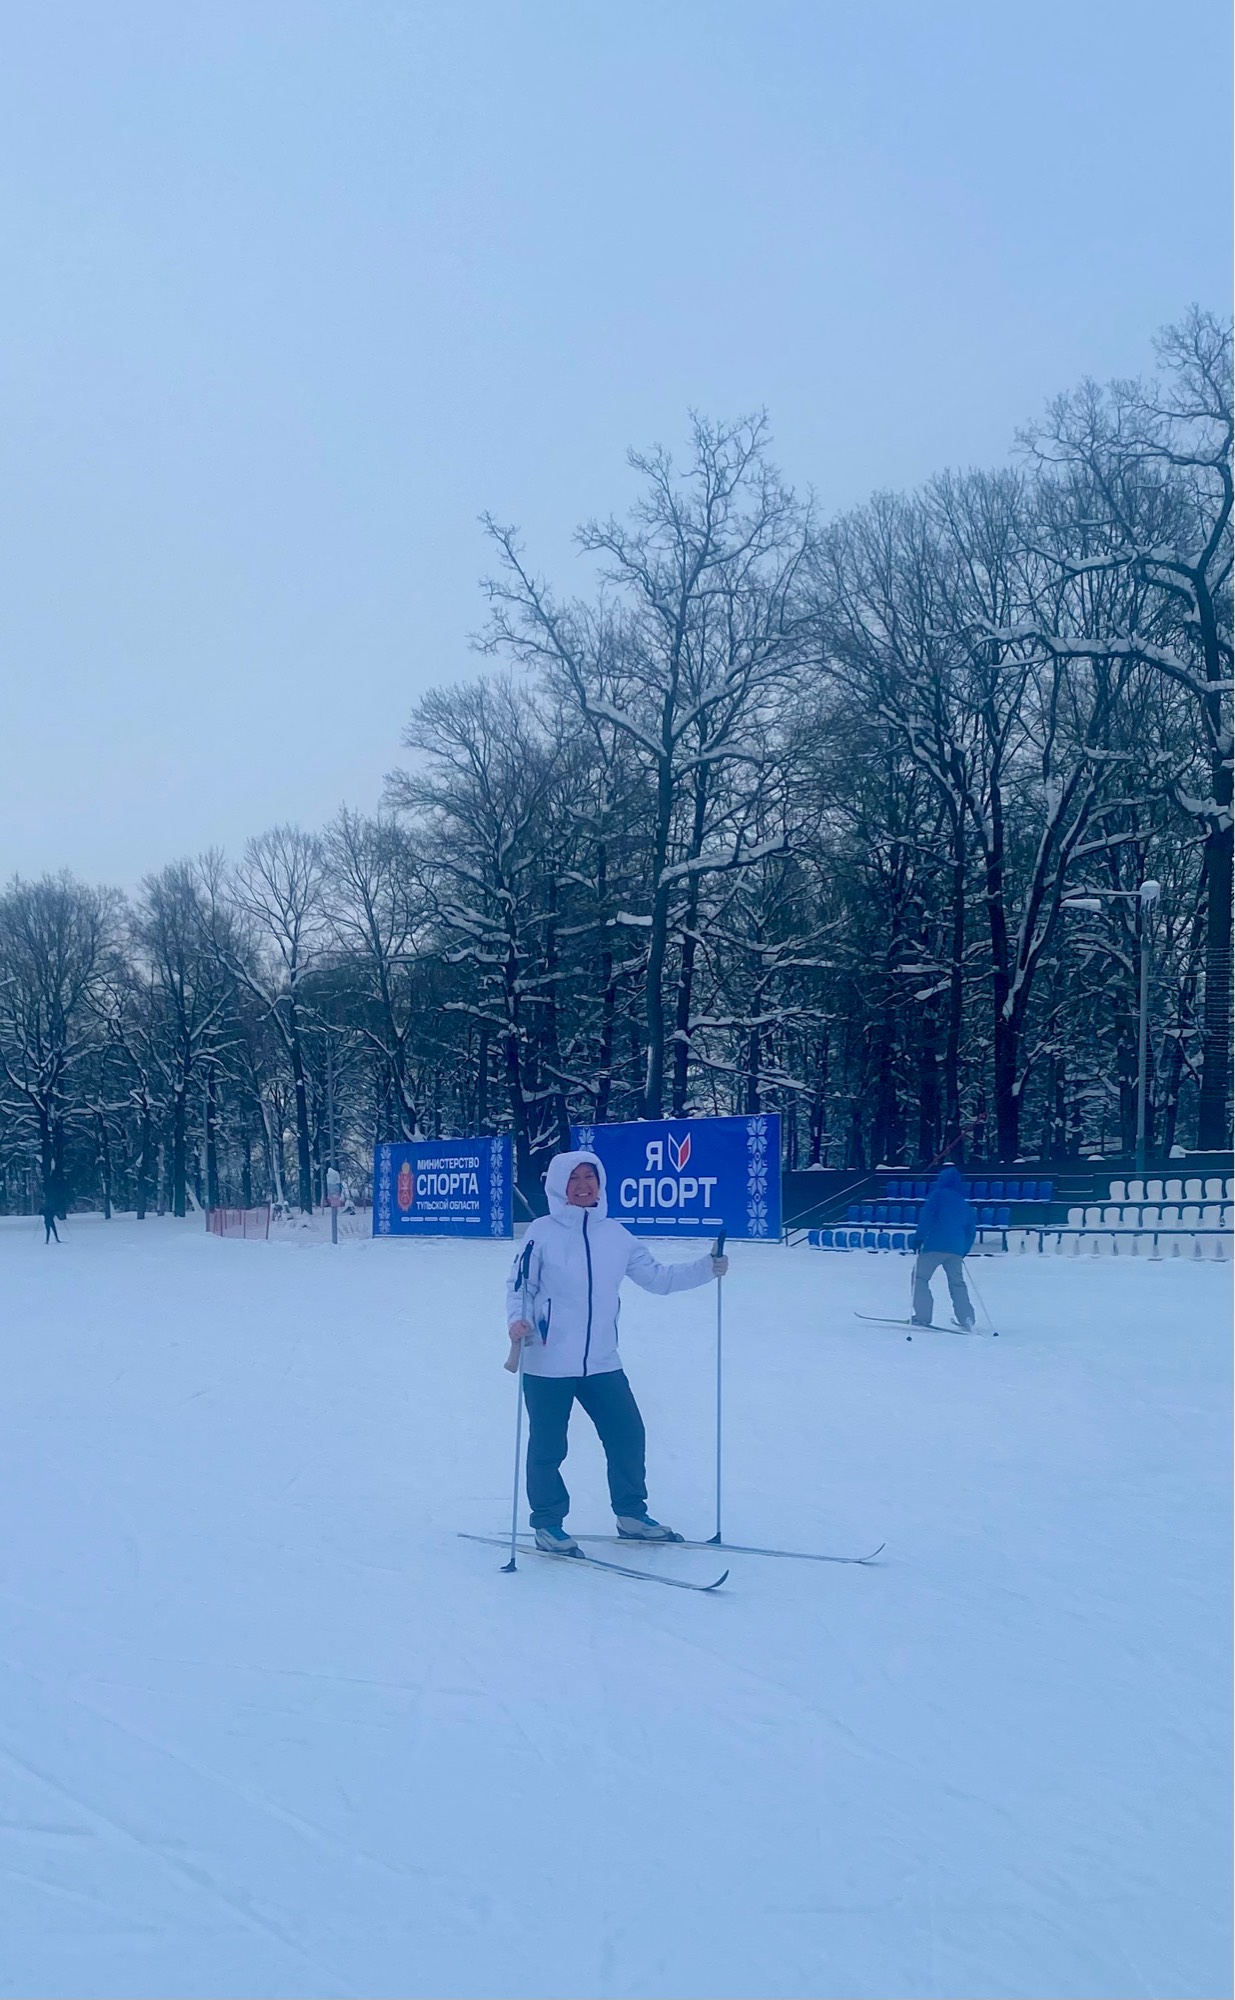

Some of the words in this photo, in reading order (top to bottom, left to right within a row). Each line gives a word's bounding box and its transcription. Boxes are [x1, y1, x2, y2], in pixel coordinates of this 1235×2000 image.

[417, 1157, 480, 1170] МИНИСТЕРСТВО
[645, 1140, 663, 1171] Я
[416, 1173, 479, 1195] СПОРТА
[620, 1177, 717, 1207] СПОРТ
[416, 1199, 448, 1210] ТУЛЬСКОЙ
[449, 1200, 480, 1210] ОБЛАСТИ
